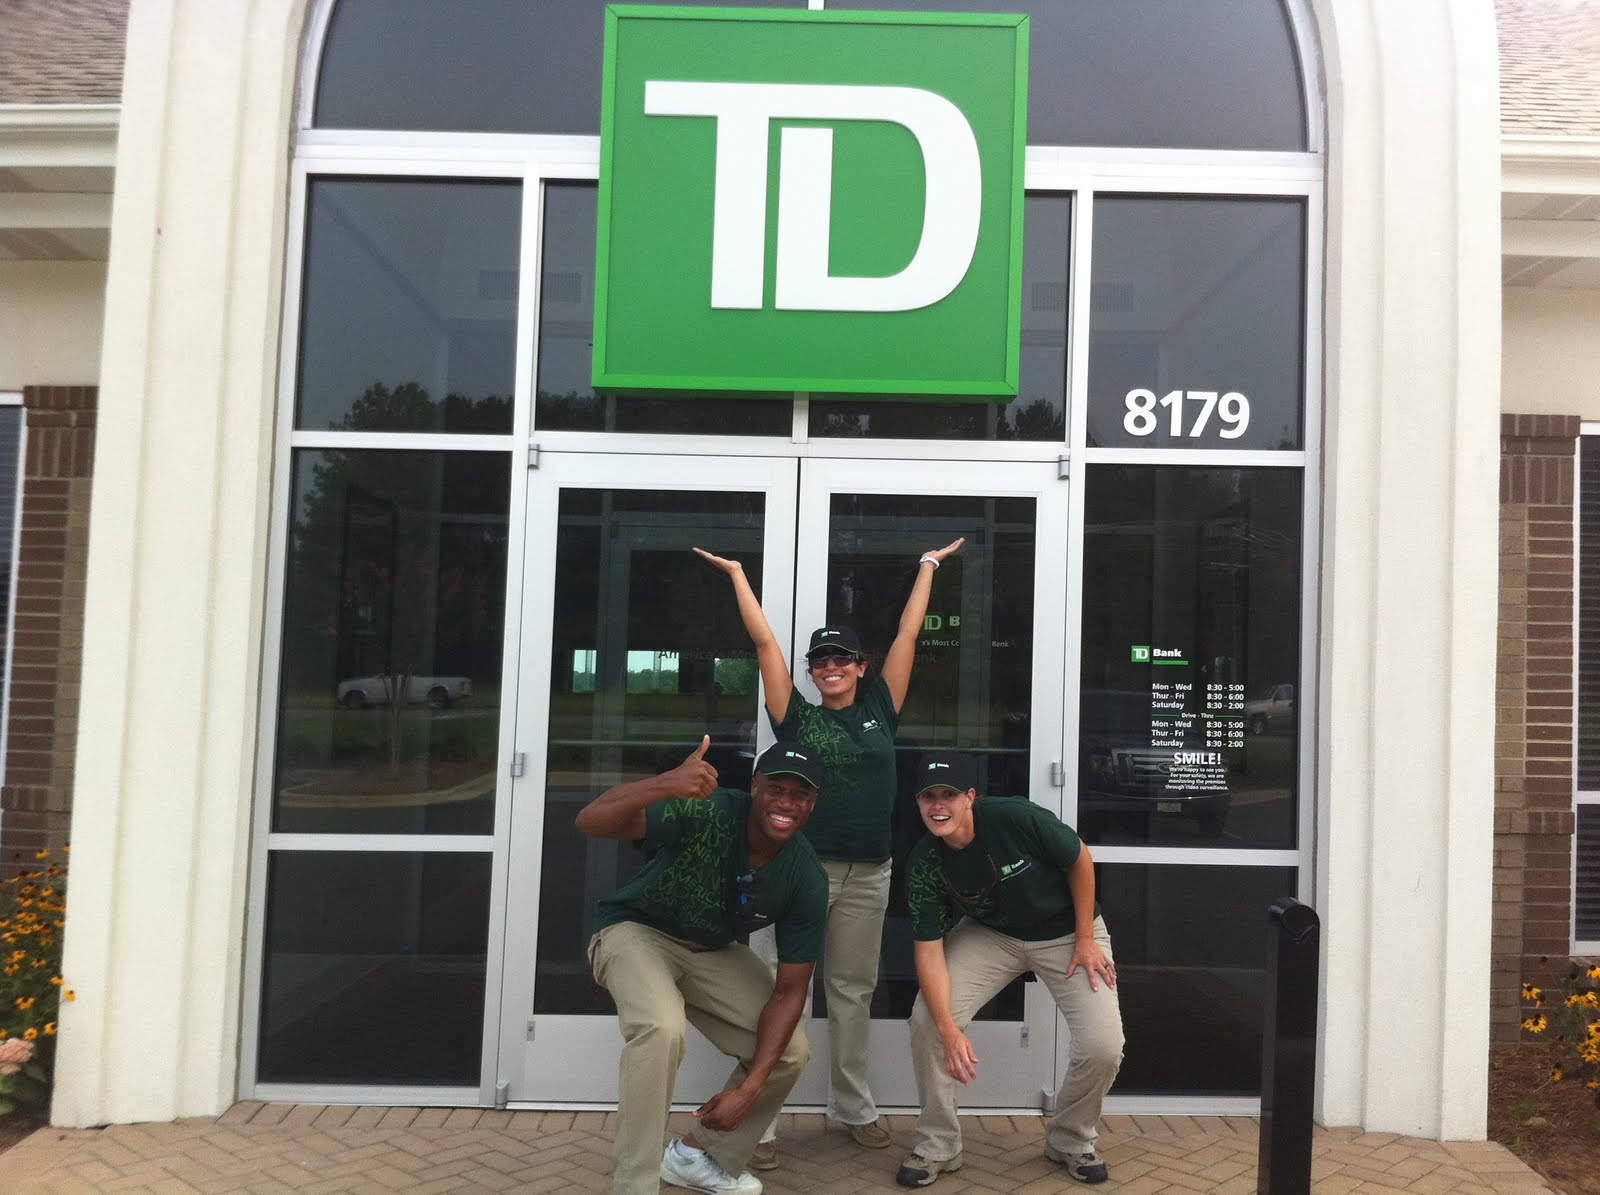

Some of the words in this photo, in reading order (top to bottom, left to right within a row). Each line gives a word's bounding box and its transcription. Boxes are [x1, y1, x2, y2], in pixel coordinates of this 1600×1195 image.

[644, 80, 982, 312] TD
[1123, 388, 1250, 440] 8179
[1132, 648, 1148, 659] TD
[1153, 649, 1182, 657] Bank
[1174, 752, 1221, 765] SMILE!
